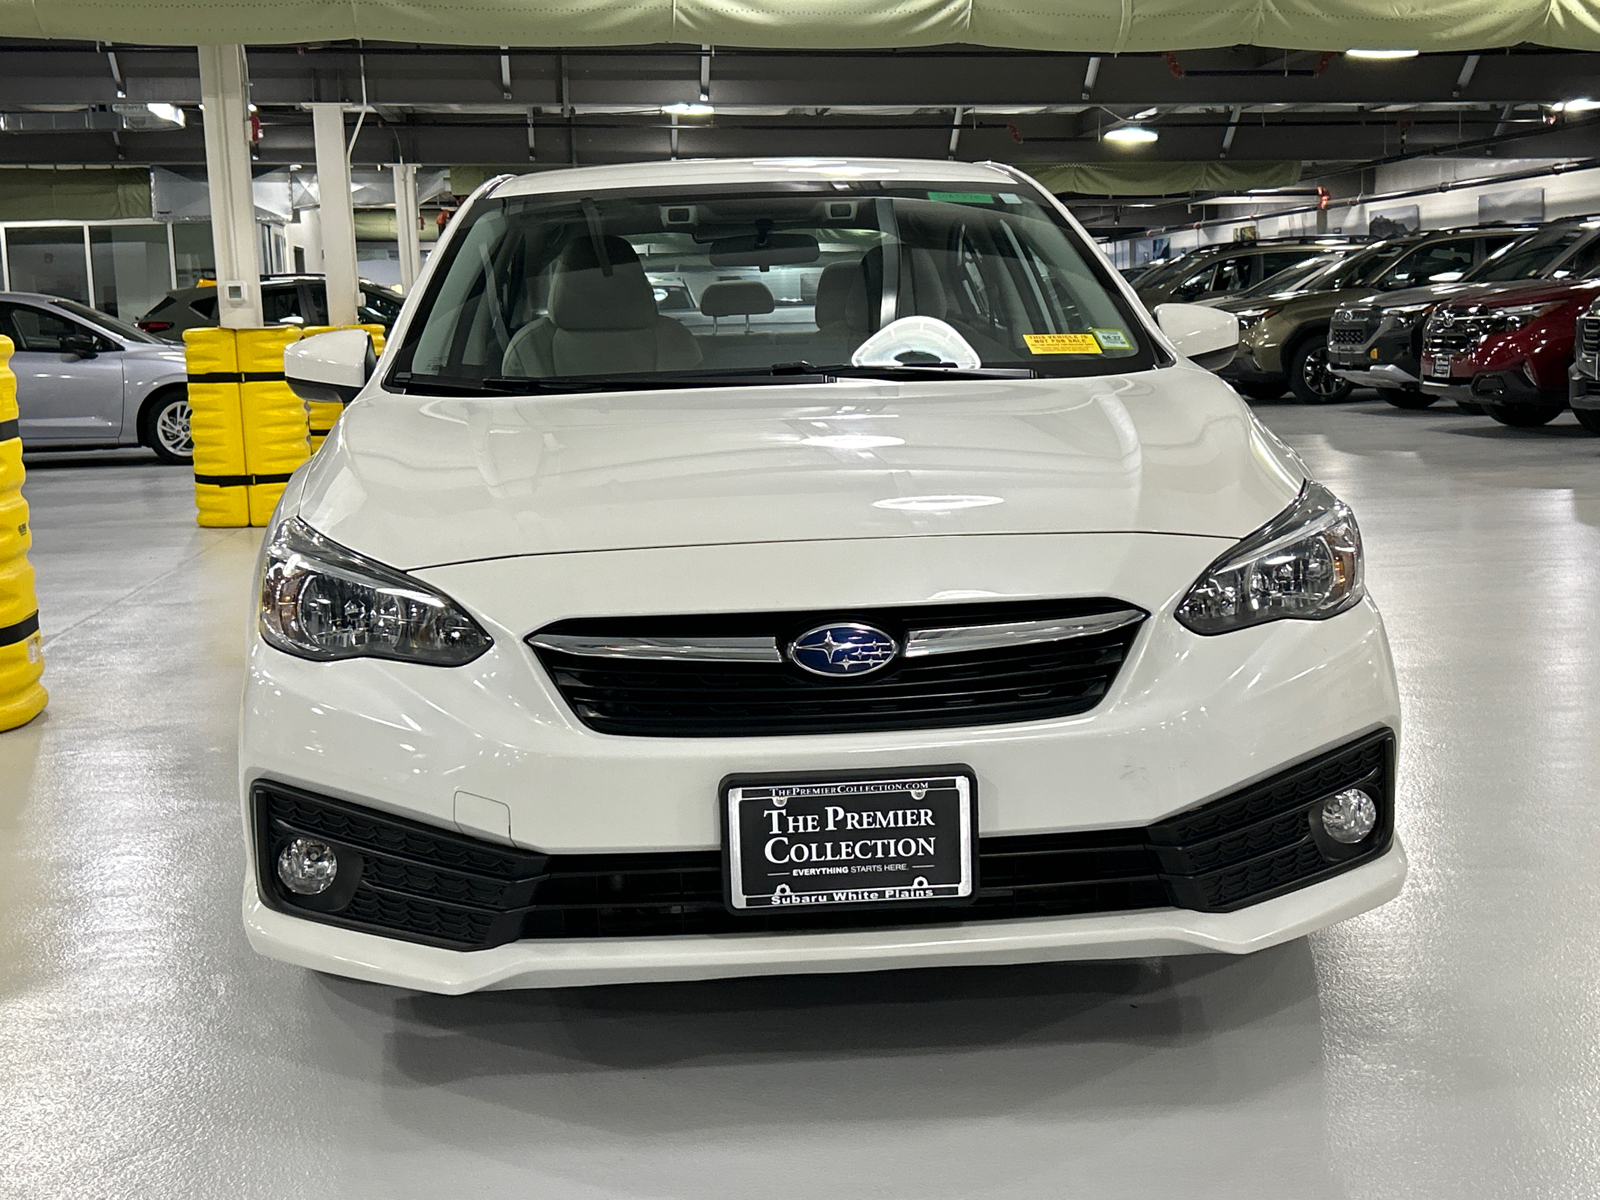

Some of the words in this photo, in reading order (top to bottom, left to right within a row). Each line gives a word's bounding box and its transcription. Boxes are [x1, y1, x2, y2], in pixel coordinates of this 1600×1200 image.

[763, 809, 820, 834] THE
[825, 806, 935, 830] PREMIER
[764, 837, 936, 864] COLLECTION
[792, 866, 849, 877] EVERYTHING
[850, 865, 882, 874] STARTS
[771, 893, 827, 906] Subaru
[832, 892, 879, 903] White
[885, 889, 934, 900] Plains
